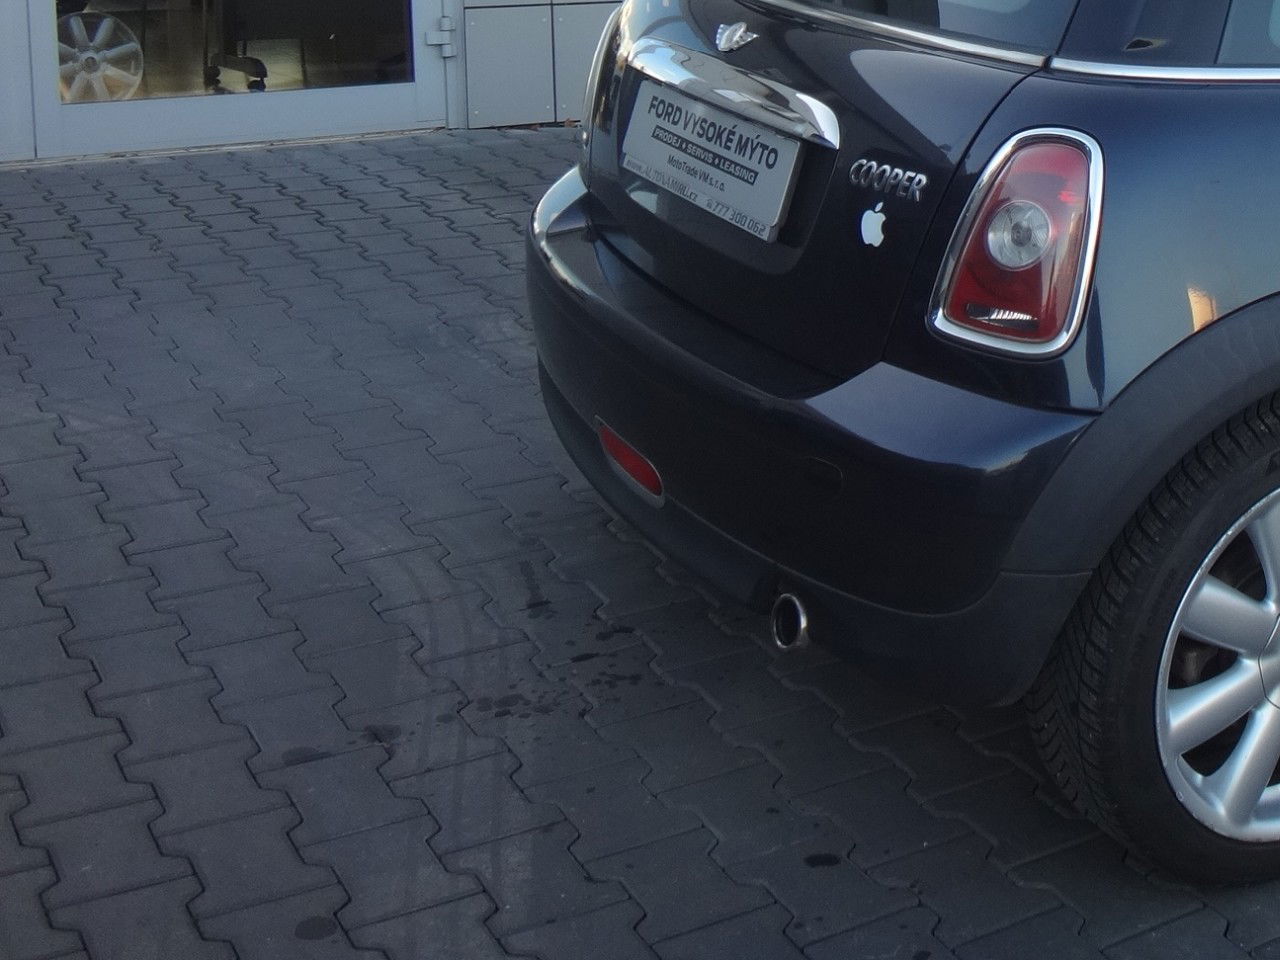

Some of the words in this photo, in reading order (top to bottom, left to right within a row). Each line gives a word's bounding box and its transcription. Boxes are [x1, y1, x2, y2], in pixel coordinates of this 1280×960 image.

[647, 95, 683, 126] FORD
[683, 110, 738, 151] VYSOKÉ
[734, 134, 778, 169] MÝTO
[653, 128, 681, 147] PRODEJ
[686, 143, 714, 163] SERVIS
[720, 158, 756, 183] LEASING
[667, 154, 699, 180] MotoTrade
[850, 158, 928, 203] COOPER
[712, 201, 730, 218] 777
